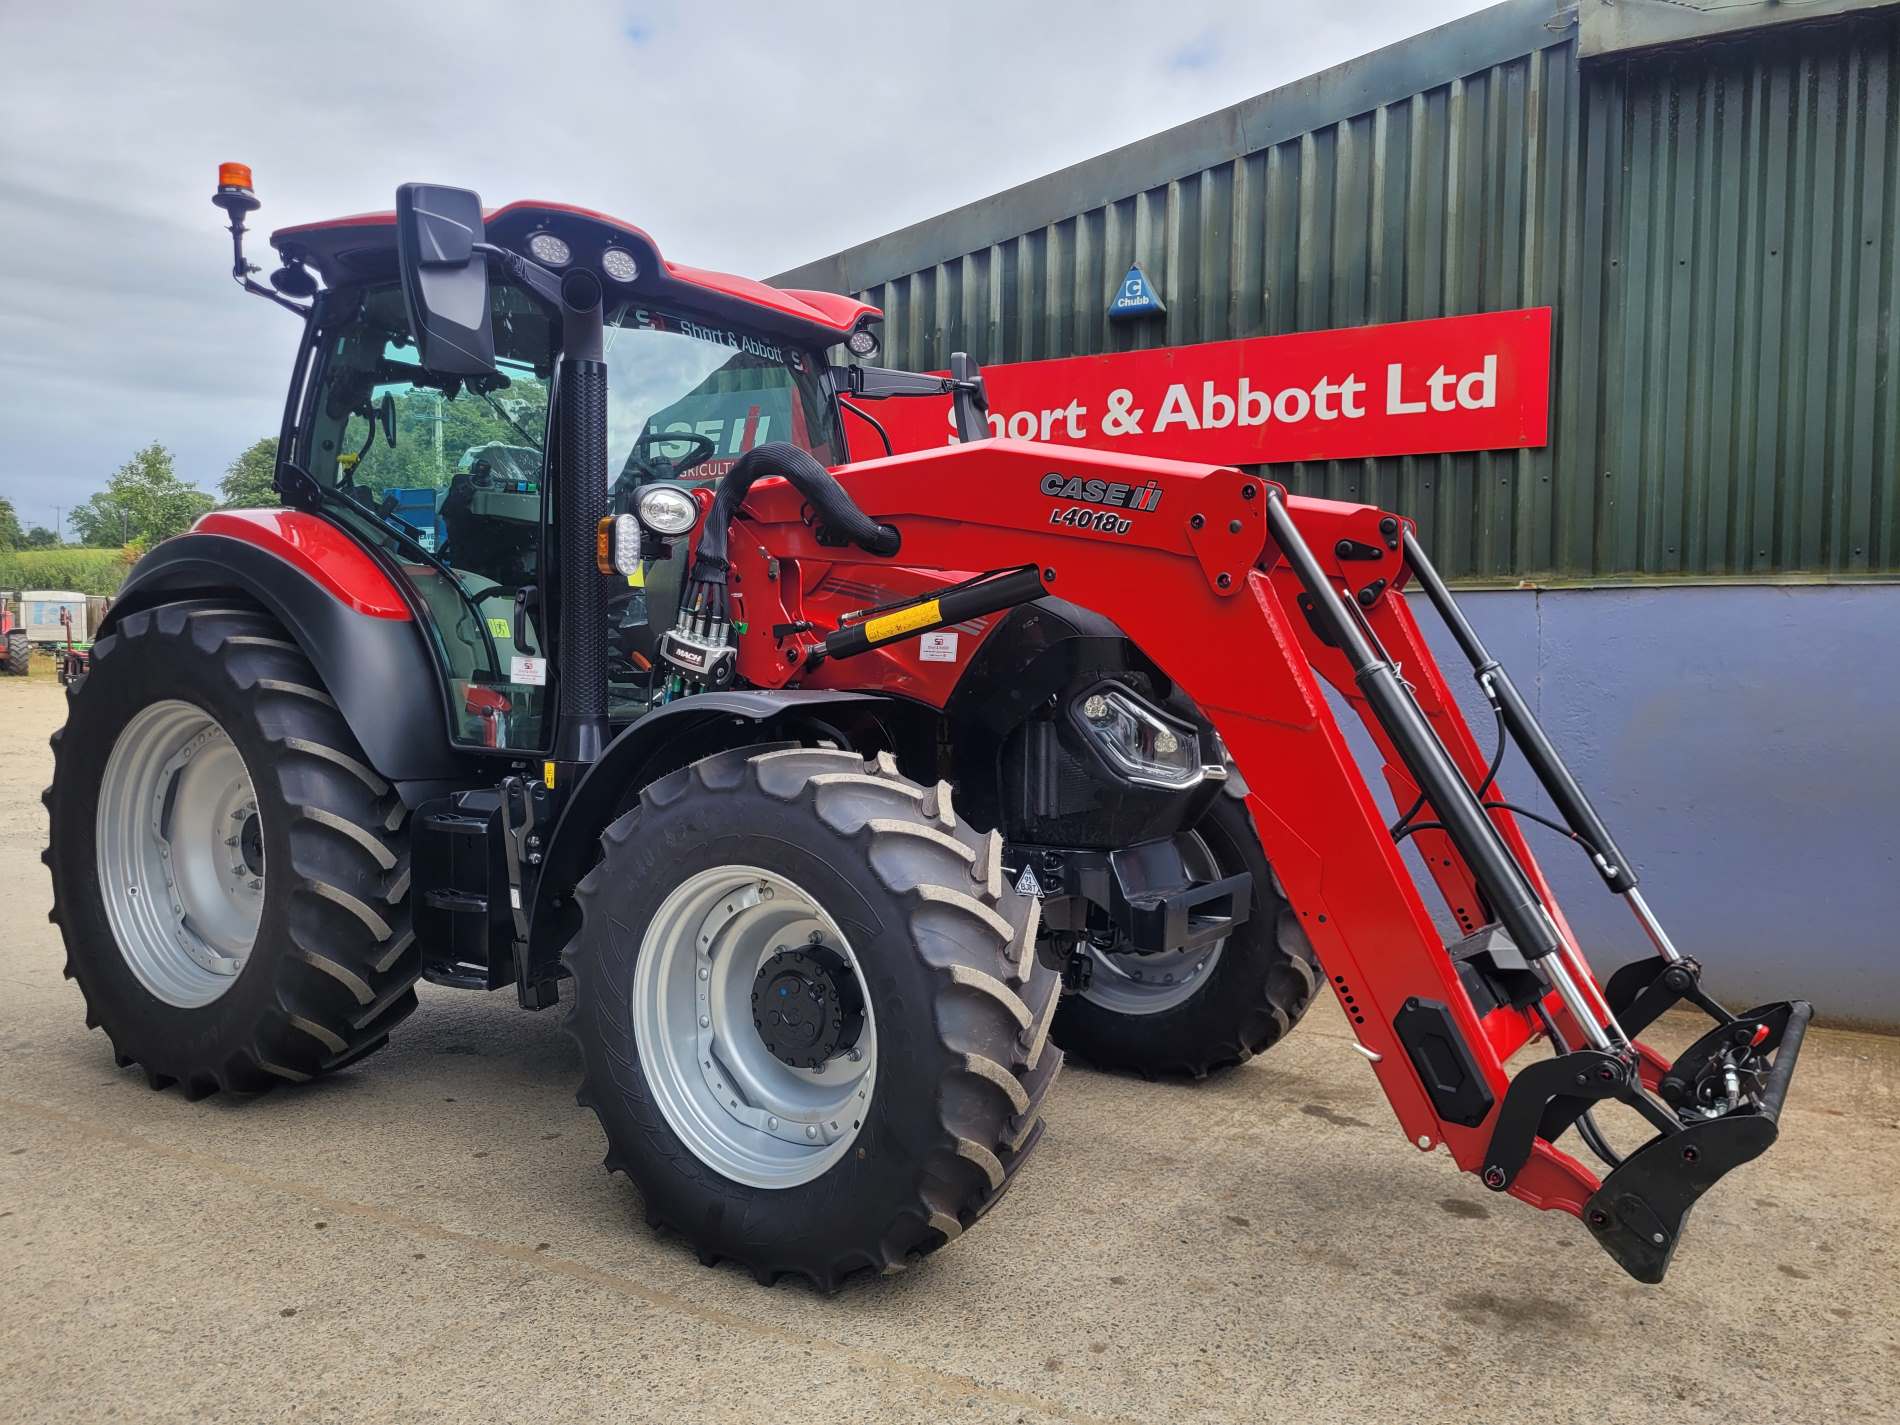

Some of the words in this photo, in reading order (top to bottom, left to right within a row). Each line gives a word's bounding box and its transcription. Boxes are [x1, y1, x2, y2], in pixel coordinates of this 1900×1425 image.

[1117, 296, 1149, 307] Chubb
[680, 320, 723, 346] Short
[728, 331, 738, 348] &
[742, 335, 783, 364] Abbott
[1101, 388, 1144, 436] &
[1152, 372, 1366, 433] Abbott
[1386, 354, 1498, 415] Ltd
[1040, 473, 1129, 506] CASE
[676, 648, 702, 662] MACH
